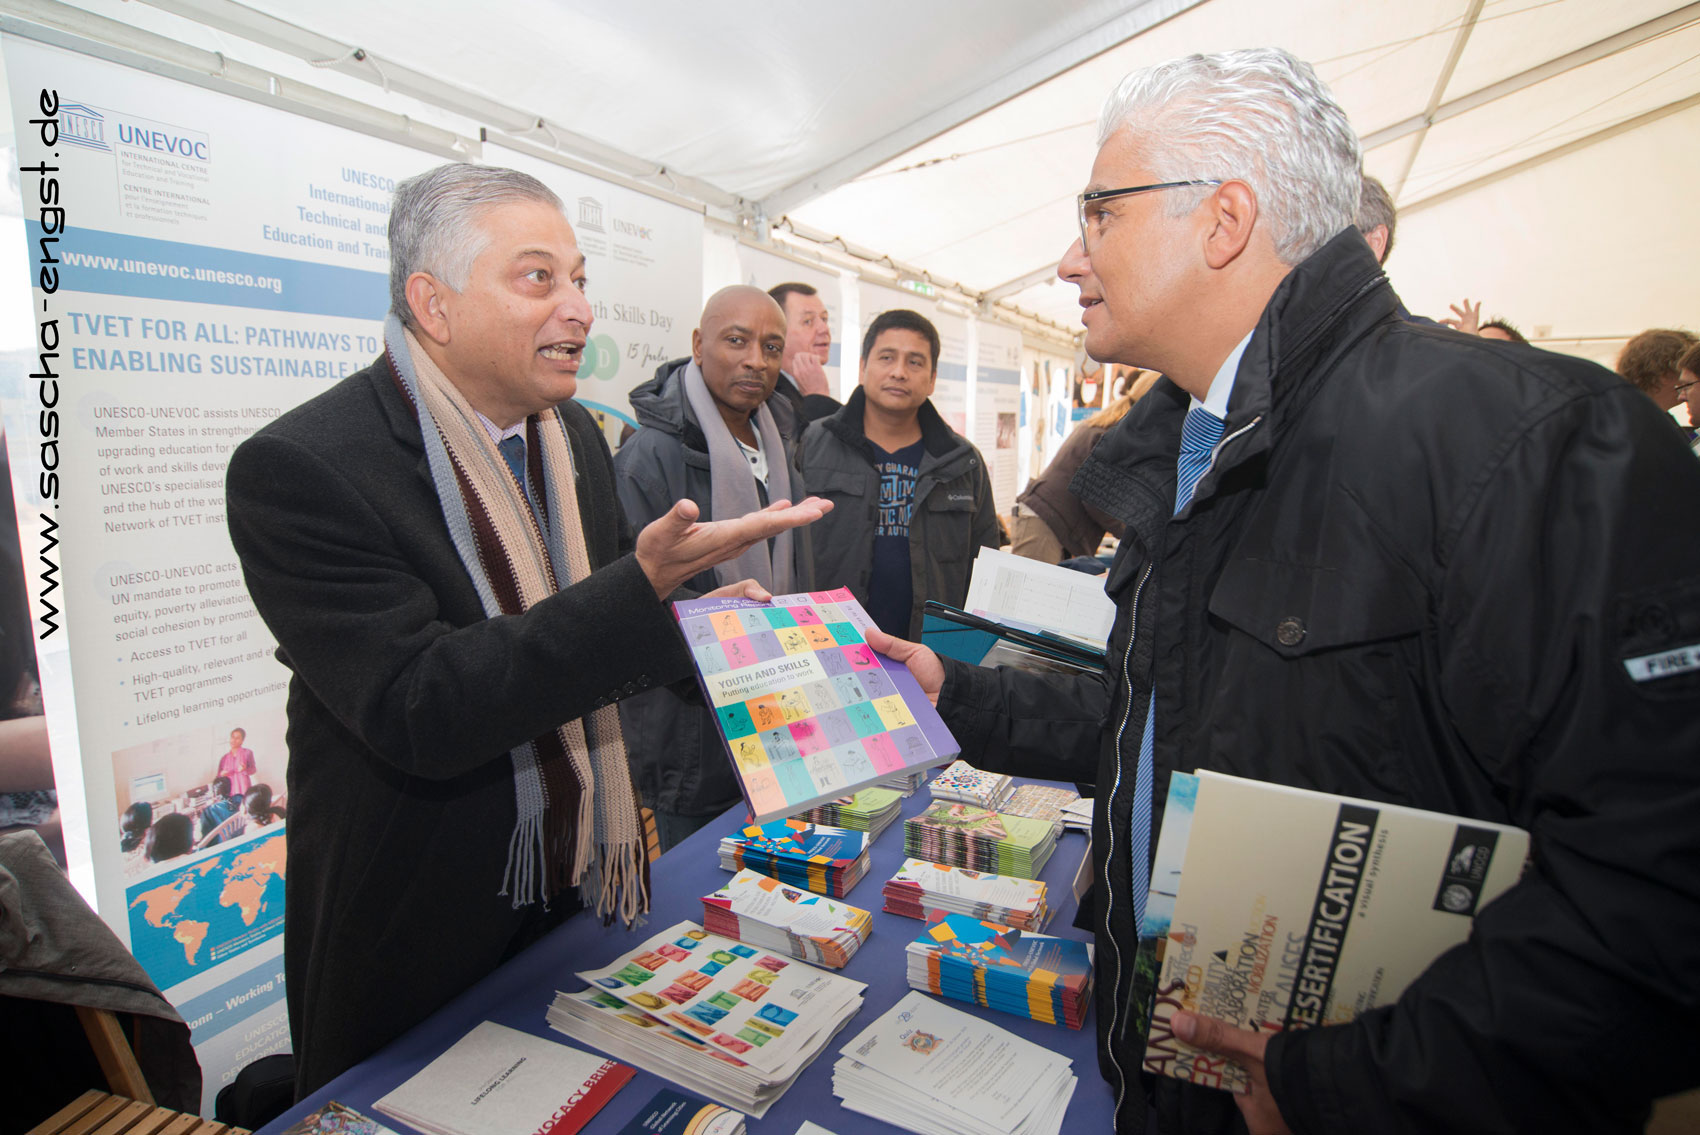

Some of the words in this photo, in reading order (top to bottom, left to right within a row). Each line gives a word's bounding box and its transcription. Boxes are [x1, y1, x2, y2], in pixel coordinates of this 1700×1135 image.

[60, 112, 104, 142] UNESCO
[118, 123, 208, 160] UNEVOC
[120, 151, 179, 169] INTERNATIONAL
[180, 163, 209, 175] CENTRE
[123, 183, 153, 196] CENTRE
[154, 189, 211, 206] INTERNATIONAL
[341, 166, 395, 193] UNESCO
[308, 183, 390, 214] International
[296, 205, 362, 233] Technical
[364, 222, 388, 238] and
[262, 224, 333, 251] Education
[337, 241, 360, 256] and
[61, 251, 283, 294] www.unevoc.unesco.org
[613, 303, 646, 326] Skills
[650, 309, 674, 333] Day
[67, 312, 133, 338] TVET
[141, 318, 188, 342] FOR
[194, 323, 240, 346] ALL:
[245, 326, 352, 353] PATHWAYS
[355, 335, 378, 355] TO
[72, 347, 204, 374] ENABLING
[210, 354, 348, 380] SUSTAINABLE
[627, 342, 640, 360] 15
[93, 406, 200, 419] UNESCO-UNEVOC
[203, 408, 239, 419] assists
[241, 407, 282, 419] UNESCO
[95, 426, 145, 438] Member
[148, 425, 185, 438] States
[188, 426, 199, 437] in
[97, 446, 156, 460] upgrading
[159, 444, 213, 456] education
[215, 443, 230, 454] for
[99, 465, 111, 477] of
[114, 463, 145, 476] work
[147, 462, 168, 474] and
[171, 461, 199, 473] skills
[101, 481, 161, 496] UNESCO's
[164, 479, 224, 492] specialised
[103, 502, 125, 515] and
[128, 500, 147, 513] the
[150, 498, 171, 511] hub
[174, 497, 186, 509] of
[187, 497, 206, 508] the
[208, 496, 225, 507] wo
[105, 517, 156, 533] Network
[158, 515, 170, 528] of
[172, 514, 202, 527] TVET
[110, 564, 213, 587] UNESCO-UNEVOC
[215, 562, 238, 574] acts
[111, 592, 131, 606] UN
[133, 587, 182, 602] mandate
[185, 584, 196, 595] to
[199, 578, 242, 593] promote
[113, 608, 152, 624] equity,
[154, 601, 197, 618] poverty
[688, 602, 739, 615] Monitoring
[115, 626, 149, 642] social
[151, 618, 201, 635] cohesion
[203, 614, 216, 627] by
[130, 646, 172, 663] Access
[174, 643, 186, 654] to
[188, 636, 218, 652] TVET
[220, 633, 234, 645] for
[236, 630, 248, 641] all
[132, 663, 201, 686] High-quality,
[203, 653, 244, 671] relevant
[246, 649, 263, 661] and
[718, 673, 753, 689] YOUTH
[755, 667, 777, 681] AND
[777, 659, 810, 674] SKILLS
[134, 686, 165, 703] TVET
[168, 673, 234, 695] programmes
[722, 686, 750, 698] Putting
[750, 677, 786, 691] education
[787, 673, 795, 681] to
[796, 668, 815, 678] work
[136, 706, 180, 726] Lifelong
[183, 696, 225, 714] learning
[227, 680, 287, 704] opportunities
[1360, 879, 1375, 910] visual
[1369, 829, 1390, 878] synthesis
[1248, 914, 1279, 995] MOBILIZATION
[225, 981, 274, 1010] Working
[471, 1080, 501, 1105] LIFELONG
[499, 1057, 527, 1081] LEARNING
[583, 1059, 618, 1089] BRIEF
